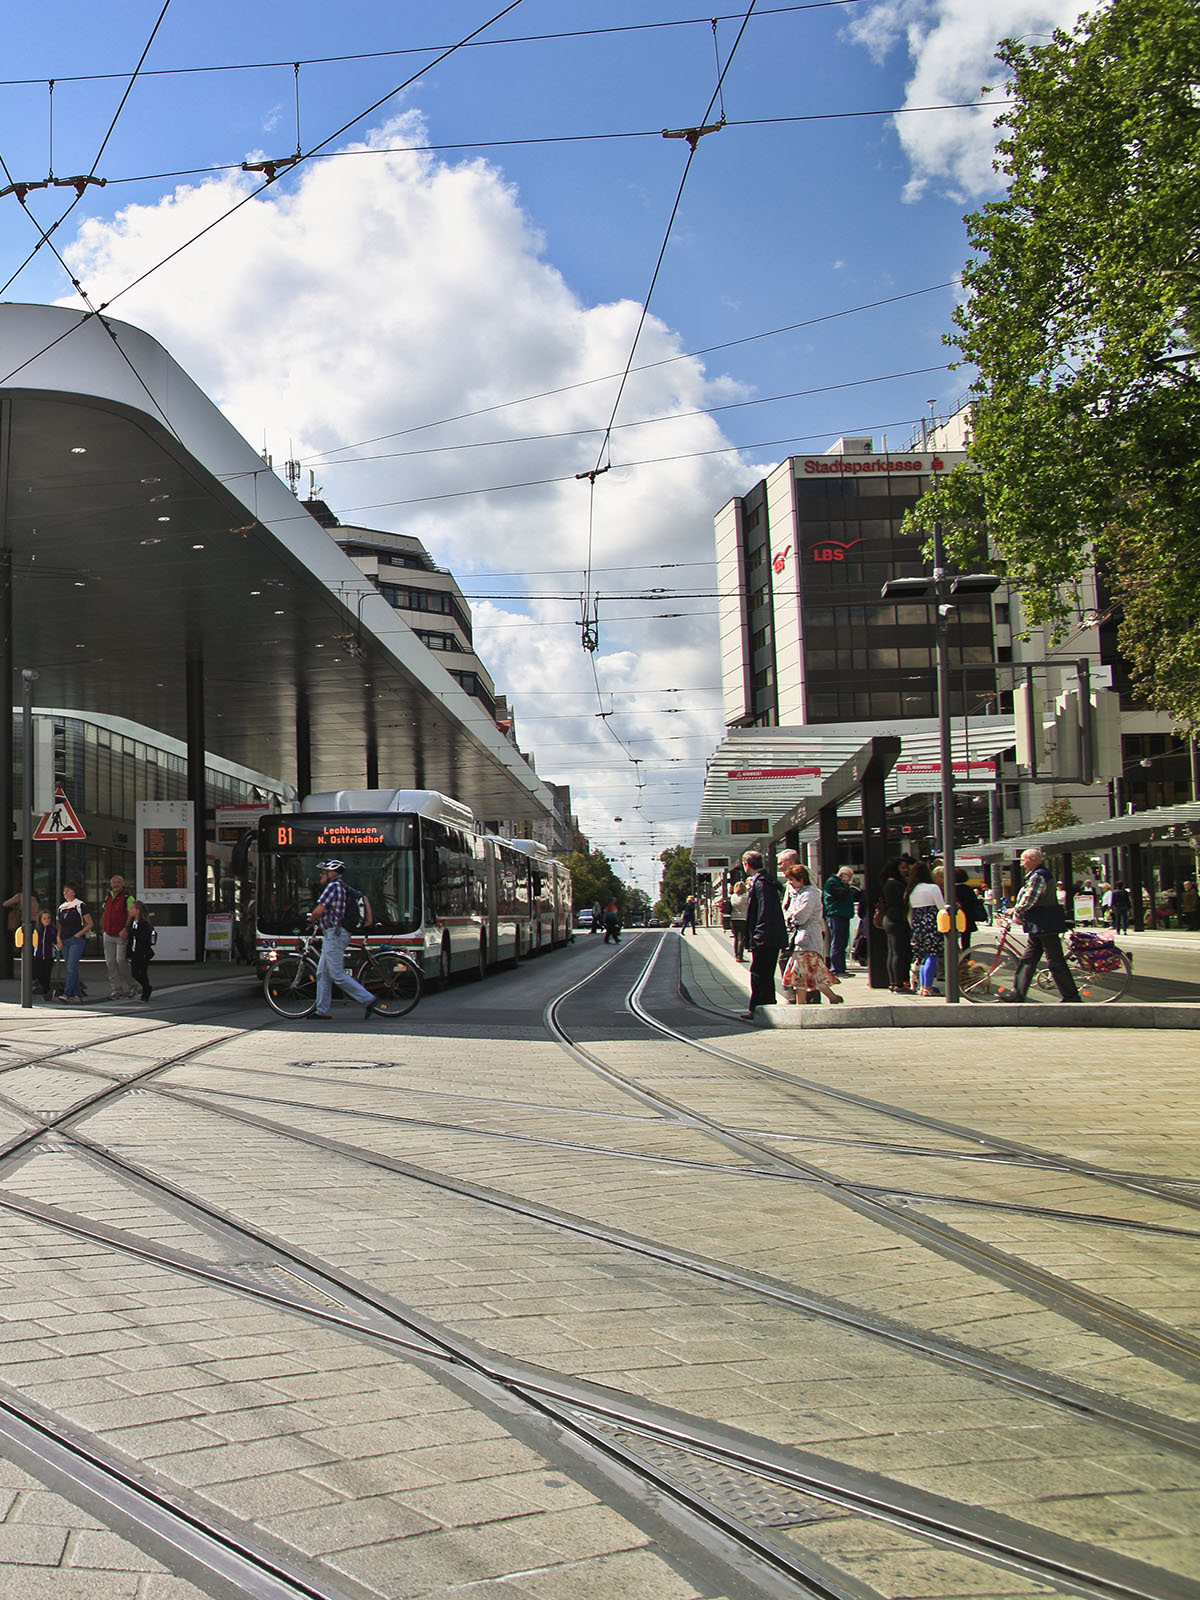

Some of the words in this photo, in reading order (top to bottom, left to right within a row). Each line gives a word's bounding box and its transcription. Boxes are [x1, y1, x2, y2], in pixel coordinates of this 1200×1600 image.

[804, 459, 922, 474] Stadtsparkasse
[813, 549, 844, 561] LBS
[278, 827, 293, 845] B1
[323, 826, 377, 835] Lechhausen
[317, 836, 327, 844] N.
[330, 835, 384, 844] Ostfriedhof
